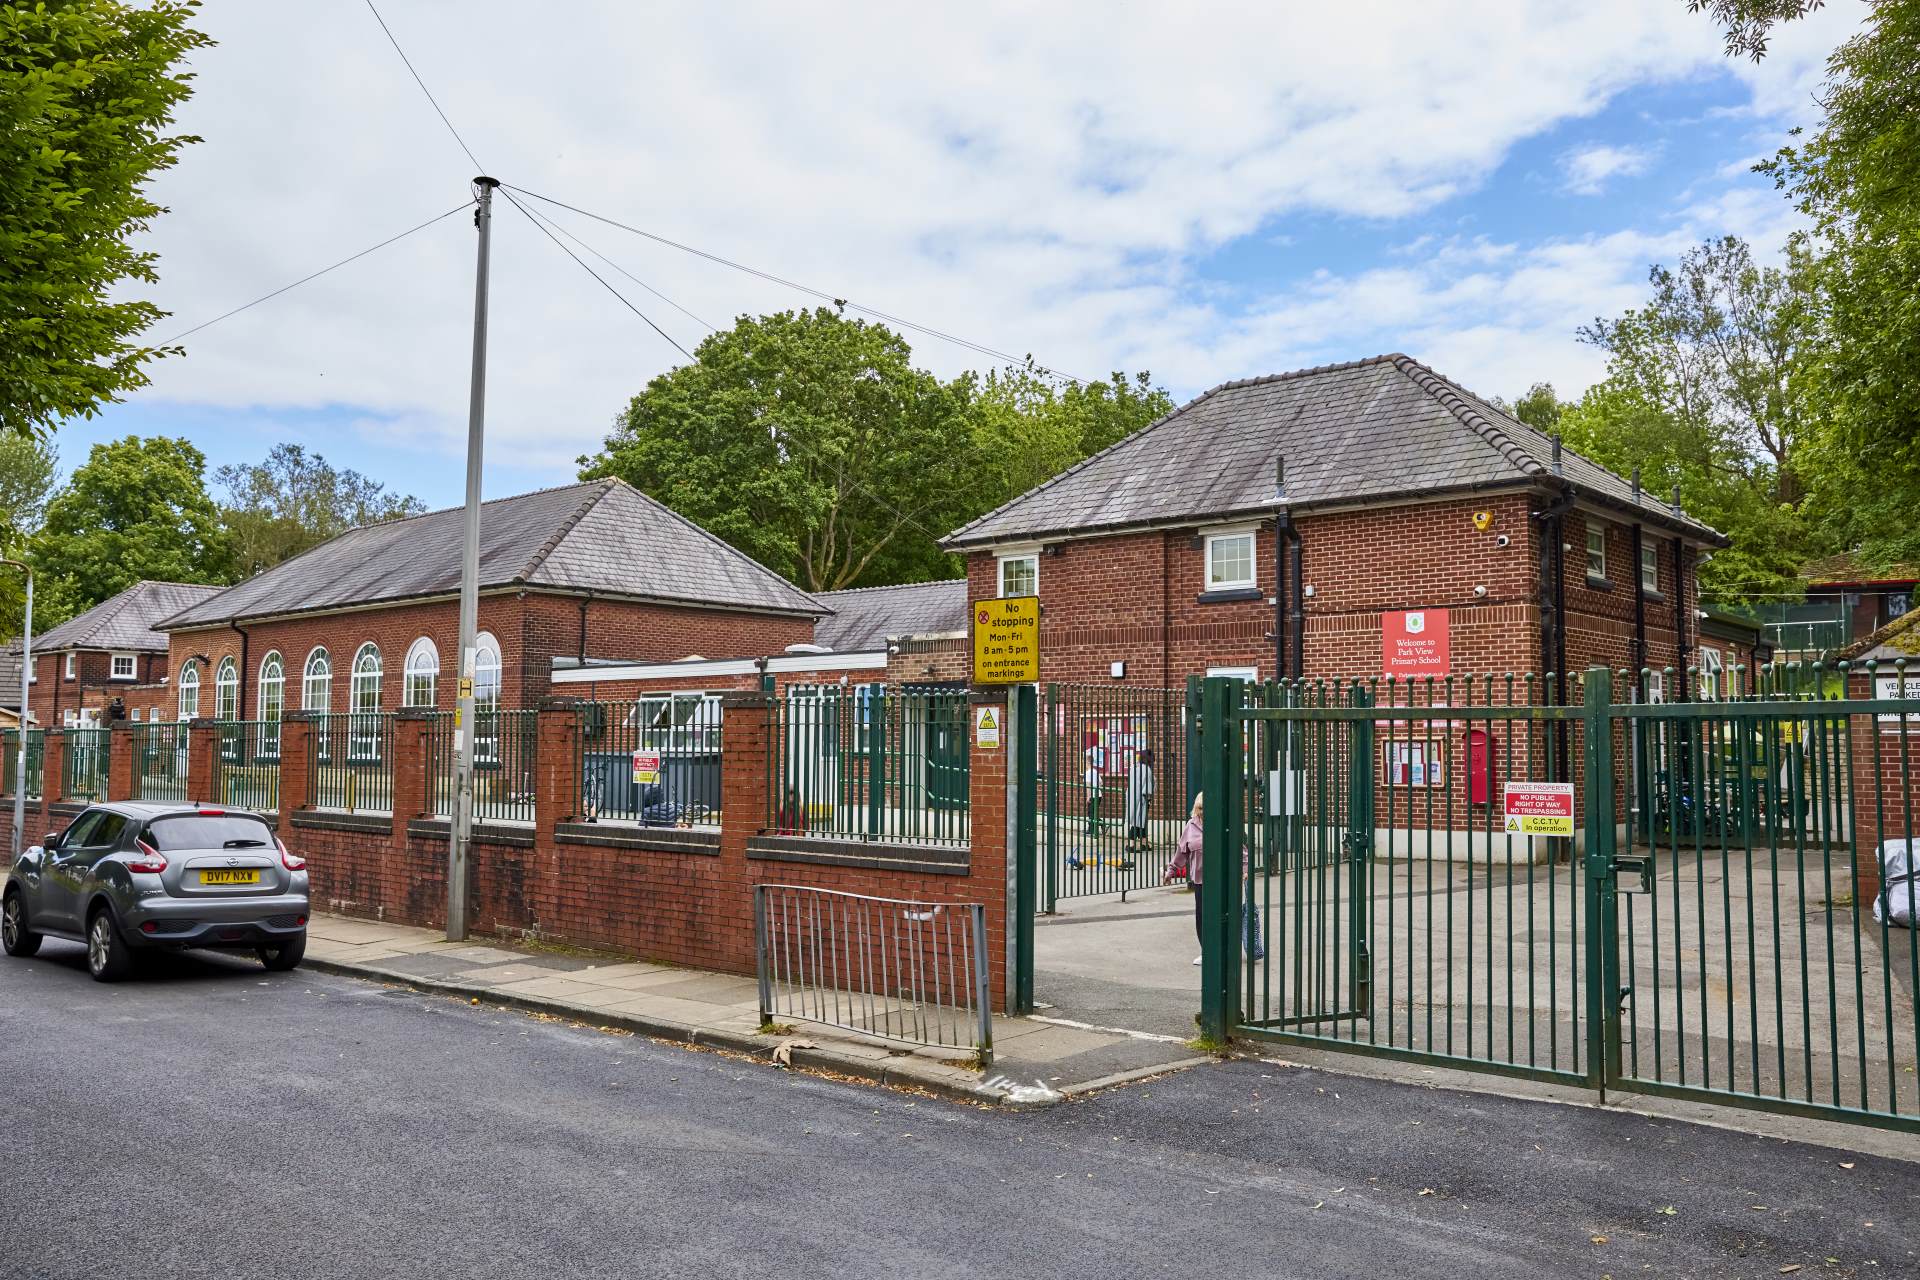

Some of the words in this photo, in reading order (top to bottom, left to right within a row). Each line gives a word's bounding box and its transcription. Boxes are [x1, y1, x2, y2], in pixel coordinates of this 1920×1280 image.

[1005, 604, 1020, 613] No
[992, 616, 1034, 628] stopping
[1396, 639, 1427, 647] Welcome
[984, 646, 989, 655] 8
[1015, 646, 1029, 655] pm
[1398, 648, 1413, 656] Park
[1415, 647, 1434, 655] View
[994, 659, 1030, 668] entrance
[1391, 657, 1417, 667] Primary
[1418, 656, 1441, 664] School
[987, 669, 1025, 679] markings
[1886, 682, 1920, 690] VECLE
[1889, 691, 1920, 699] PAKE
[207, 871, 230, 881] DV17
[233, 871, 253, 881] NXW
